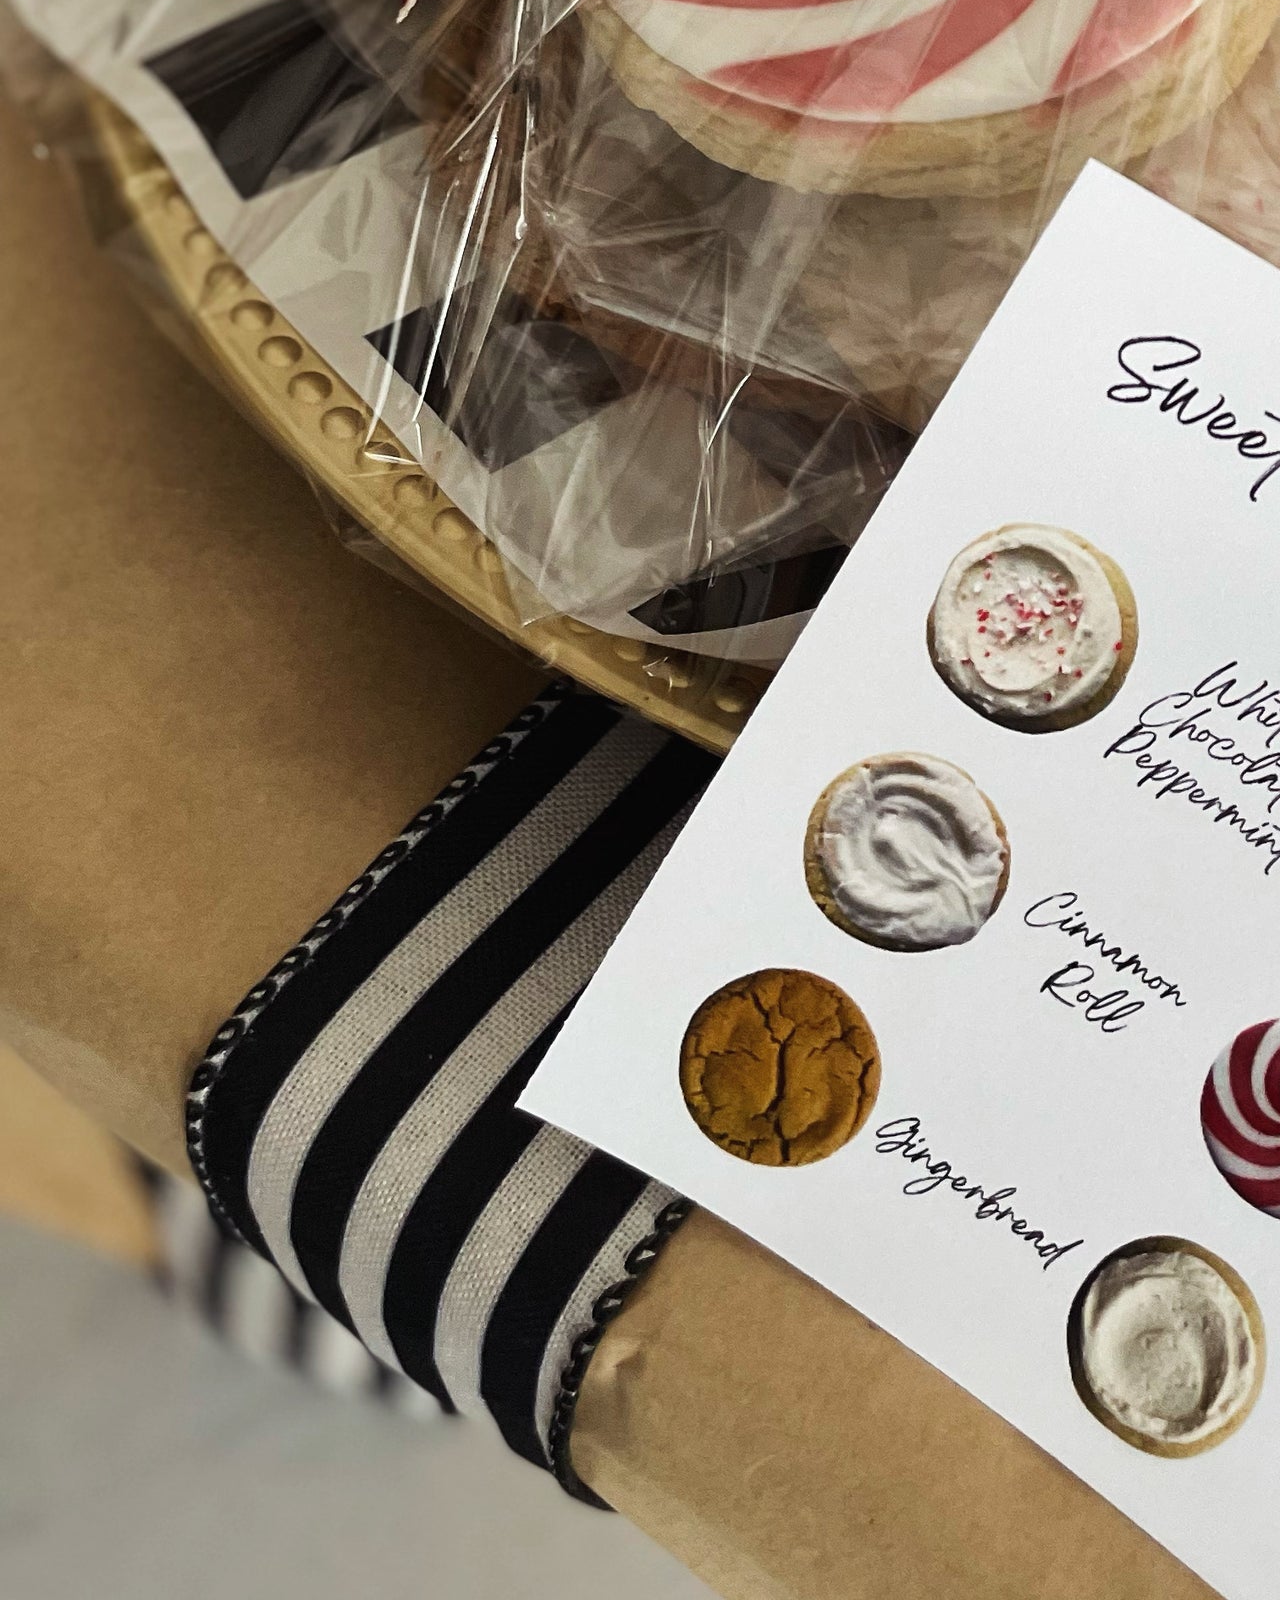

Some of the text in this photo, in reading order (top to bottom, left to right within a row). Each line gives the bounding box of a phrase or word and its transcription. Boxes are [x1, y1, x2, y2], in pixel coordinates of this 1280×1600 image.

[1023, 892, 1187, 1007] Cinnamon
[1039, 960, 1146, 1034] Roll
[875, 1116, 1085, 1272] Gingerbread
